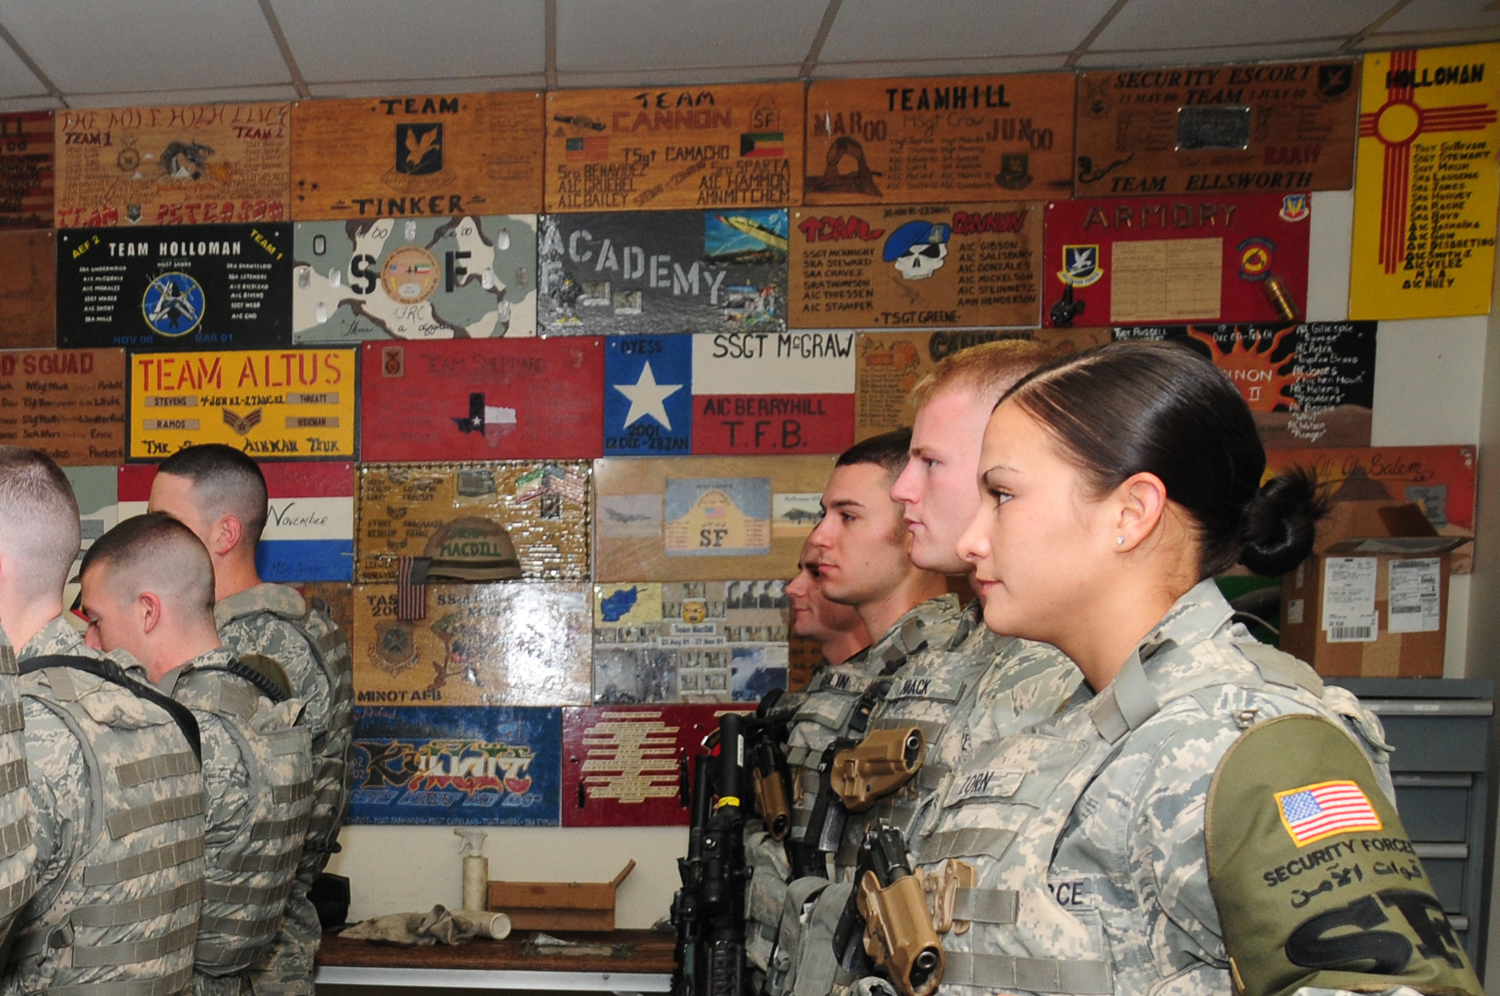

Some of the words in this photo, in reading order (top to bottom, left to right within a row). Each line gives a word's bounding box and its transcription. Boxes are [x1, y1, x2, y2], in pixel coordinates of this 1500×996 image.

[1114, 69, 1220, 90] SECURITY
[1227, 65, 1313, 84] ESCORT
[1385, 63, 1485, 89] HOLLOMAN
[633, 91, 716, 110] TEAM
[1185, 89, 1243, 105] TEAM
[379, 98, 459, 115] TEAM
[612, 109, 732, 132] CANNON
[754, 112, 774, 128] SF
[666, 145, 730, 162] CAMACHO
[736, 159, 790, 173] SPARTA
[1111, 176, 1167, 193] TEAM
[1185, 172, 1314, 191] ELLSWORTH
[352, 195, 465, 215] TINKER
[584, 193, 629, 208] BAILEY
[1083, 203, 1238, 230] ARMORY
[109, 242, 149, 257] TEAM
[159, 241, 241, 256] HOLLOMAN
[251, 228, 276, 254] TEAM
[620, 339, 663, 355] DYESS
[713, 333, 768, 358] SSGT
[23, 352, 94, 375] SQUAD
[138, 356, 222, 391] TEAM
[237, 353, 342, 387] ALTUS
[154, 397, 187, 406] STEVENS
[734, 398, 827, 416] BERRYHILL
[157, 420, 186, 429] RAMOS
[699, 529, 728, 547] SF
[358, 690, 410, 702] MINOT
[958, 771, 994, 795] ZORN
[1263, 839, 1355, 887] SECURITY
